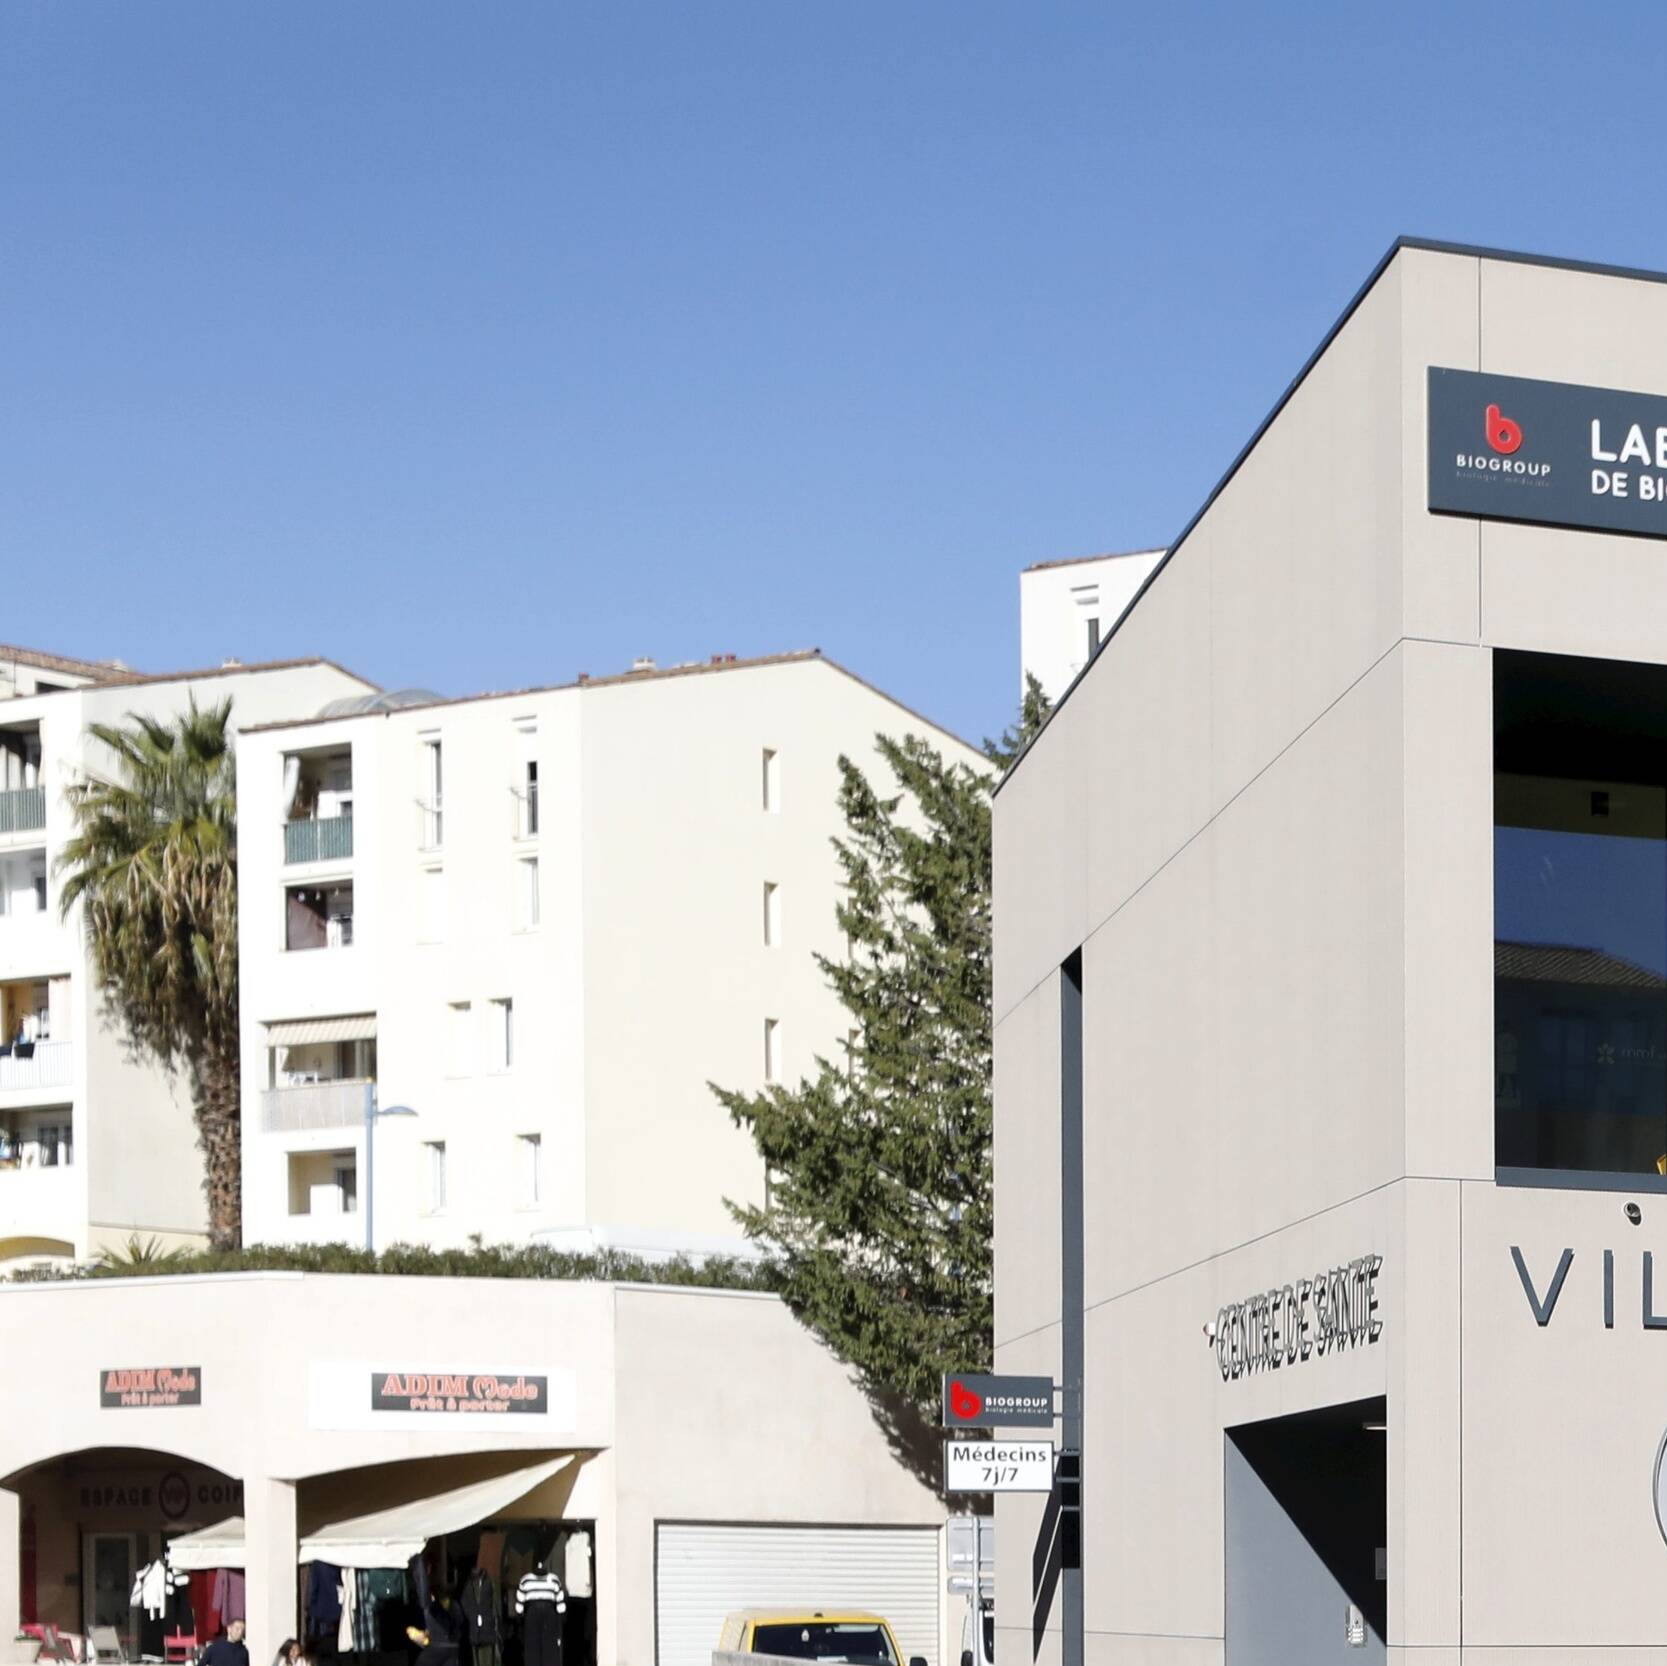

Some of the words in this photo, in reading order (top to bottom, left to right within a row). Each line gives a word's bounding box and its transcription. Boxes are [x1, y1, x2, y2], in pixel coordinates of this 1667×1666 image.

[1457, 454, 1550, 477] BIOGROUP
[1592, 469, 1628, 498] DE
[1216, 1288, 1284, 1376] CENTRE
[1283, 1278, 1313, 1357] DE
[104, 1369, 155, 1393] ADIM
[157, 1368, 196, 1392] Mode
[381, 1374, 469, 1398] ADIM
[472, 1376, 539, 1400] Mode
[985, 1396, 1048, 1407] BIOGROUP
[953, 1446, 1047, 1462] Médecins
[981, 1466, 1019, 1486] 7j/7
[80, 1485, 152, 1507] ESPACE
